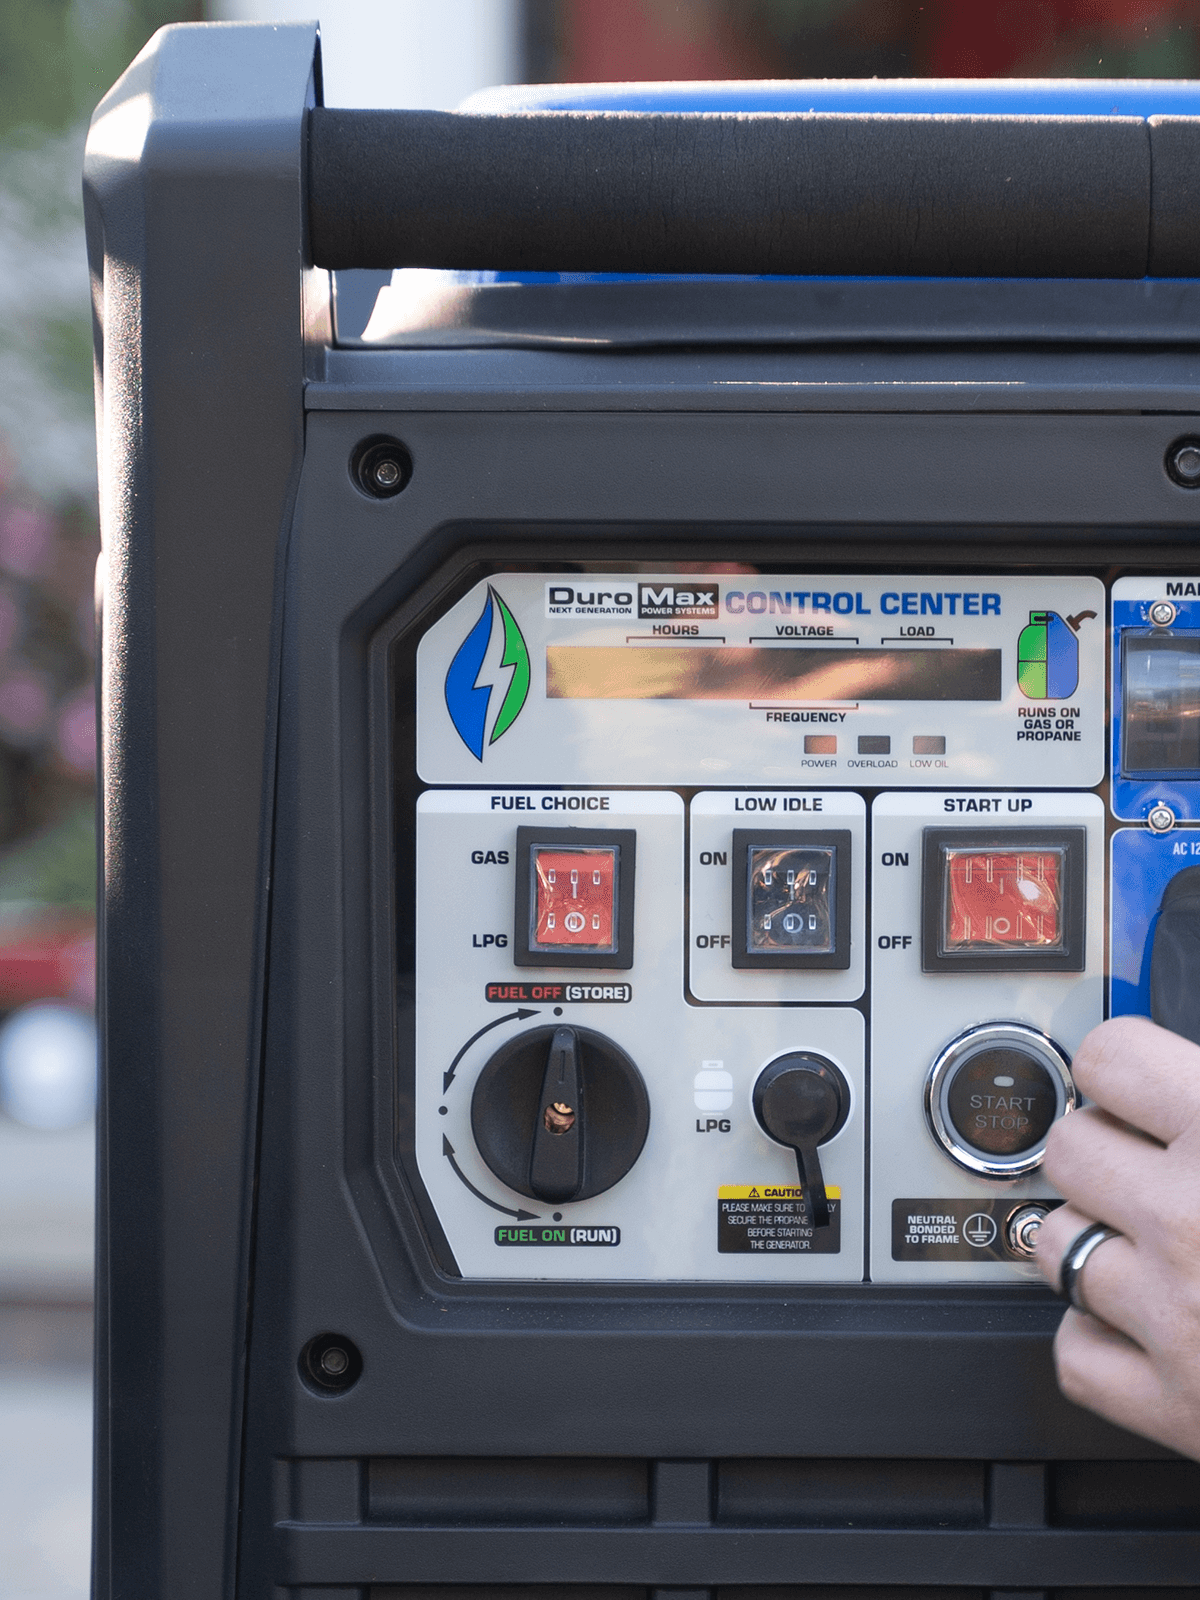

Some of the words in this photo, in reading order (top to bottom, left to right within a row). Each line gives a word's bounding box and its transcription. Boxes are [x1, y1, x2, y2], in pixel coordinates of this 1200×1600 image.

[549, 587, 633, 605] Duro
[642, 587, 714, 606] Max
[725, 591, 871, 614] CONTROL
[880, 592, 1001, 615] CENTER
[641, 607, 673, 615] POWER
[675, 607, 715, 615] SYSTEMS
[652, 625, 699, 635] HOURS
[775, 626, 834, 636] VOLTAGE
[900, 626, 935, 636] LOAD
[766, 712, 846, 722] FREQUENCY
[1018, 707, 1056, 718] RUNS
[1061, 708, 1080, 717] ON
[1024, 719, 1051, 730] GAS
[1055, 719, 1074, 730] OR
[1017, 731, 1081, 741] PROPANE
[801, 760, 837, 768] POWER
[847, 760, 898, 768] OVERLOAD
[909, 760, 931, 768] LOW
[933, 760, 949, 768] OIL
[491, 796, 536, 810] FUEL
[541, 796, 609, 810] CHOICE
[735, 798, 777, 811] LOW
[783, 798, 822, 811] IDLE
[944, 798, 1002, 812] START
[1008, 799, 1033, 812] UP
[1173, 842, 1187, 855] AC
[471, 850, 509, 864] GAS
[699, 852, 727, 866] ON
[881, 853, 909, 867] ON
[472, 934, 508, 948] LPG
[696, 936, 730, 948] OFF
[878, 936, 912, 949] OFF
[488, 987, 527, 998] FUEL
[531, 987, 562, 998] OFF
[970, 1094, 1036, 1111] START
[696, 1119, 731, 1133] LPG
[975, 1114, 1029, 1130] STOP
[764, 1188, 802, 1197] CAUTIO
[722, 1203, 749, 1212] PLEASE
[751, 1203, 773, 1212] MAKE
[774, 1203, 794, 1212] SURE
[796, 1204, 806, 1212] TO
[727, 1215, 756, 1224] SECURE
[758, 1215, 772, 1224] THE
[773, 1215, 808, 1224] PROPANE
[907, 1215, 957, 1225] NEUTRAL
[747, 1228, 775, 1237] BEFORE
[777, 1228, 813, 1237] STARTING
[909, 1225, 956, 1234] BONDED
[498, 1230, 537, 1241] FUEL
[542, 1230, 565, 1241] ON
[905, 1235, 919, 1244] TO
[921, 1235, 959, 1244] FRAME
[750, 1240, 764, 1249] THE
